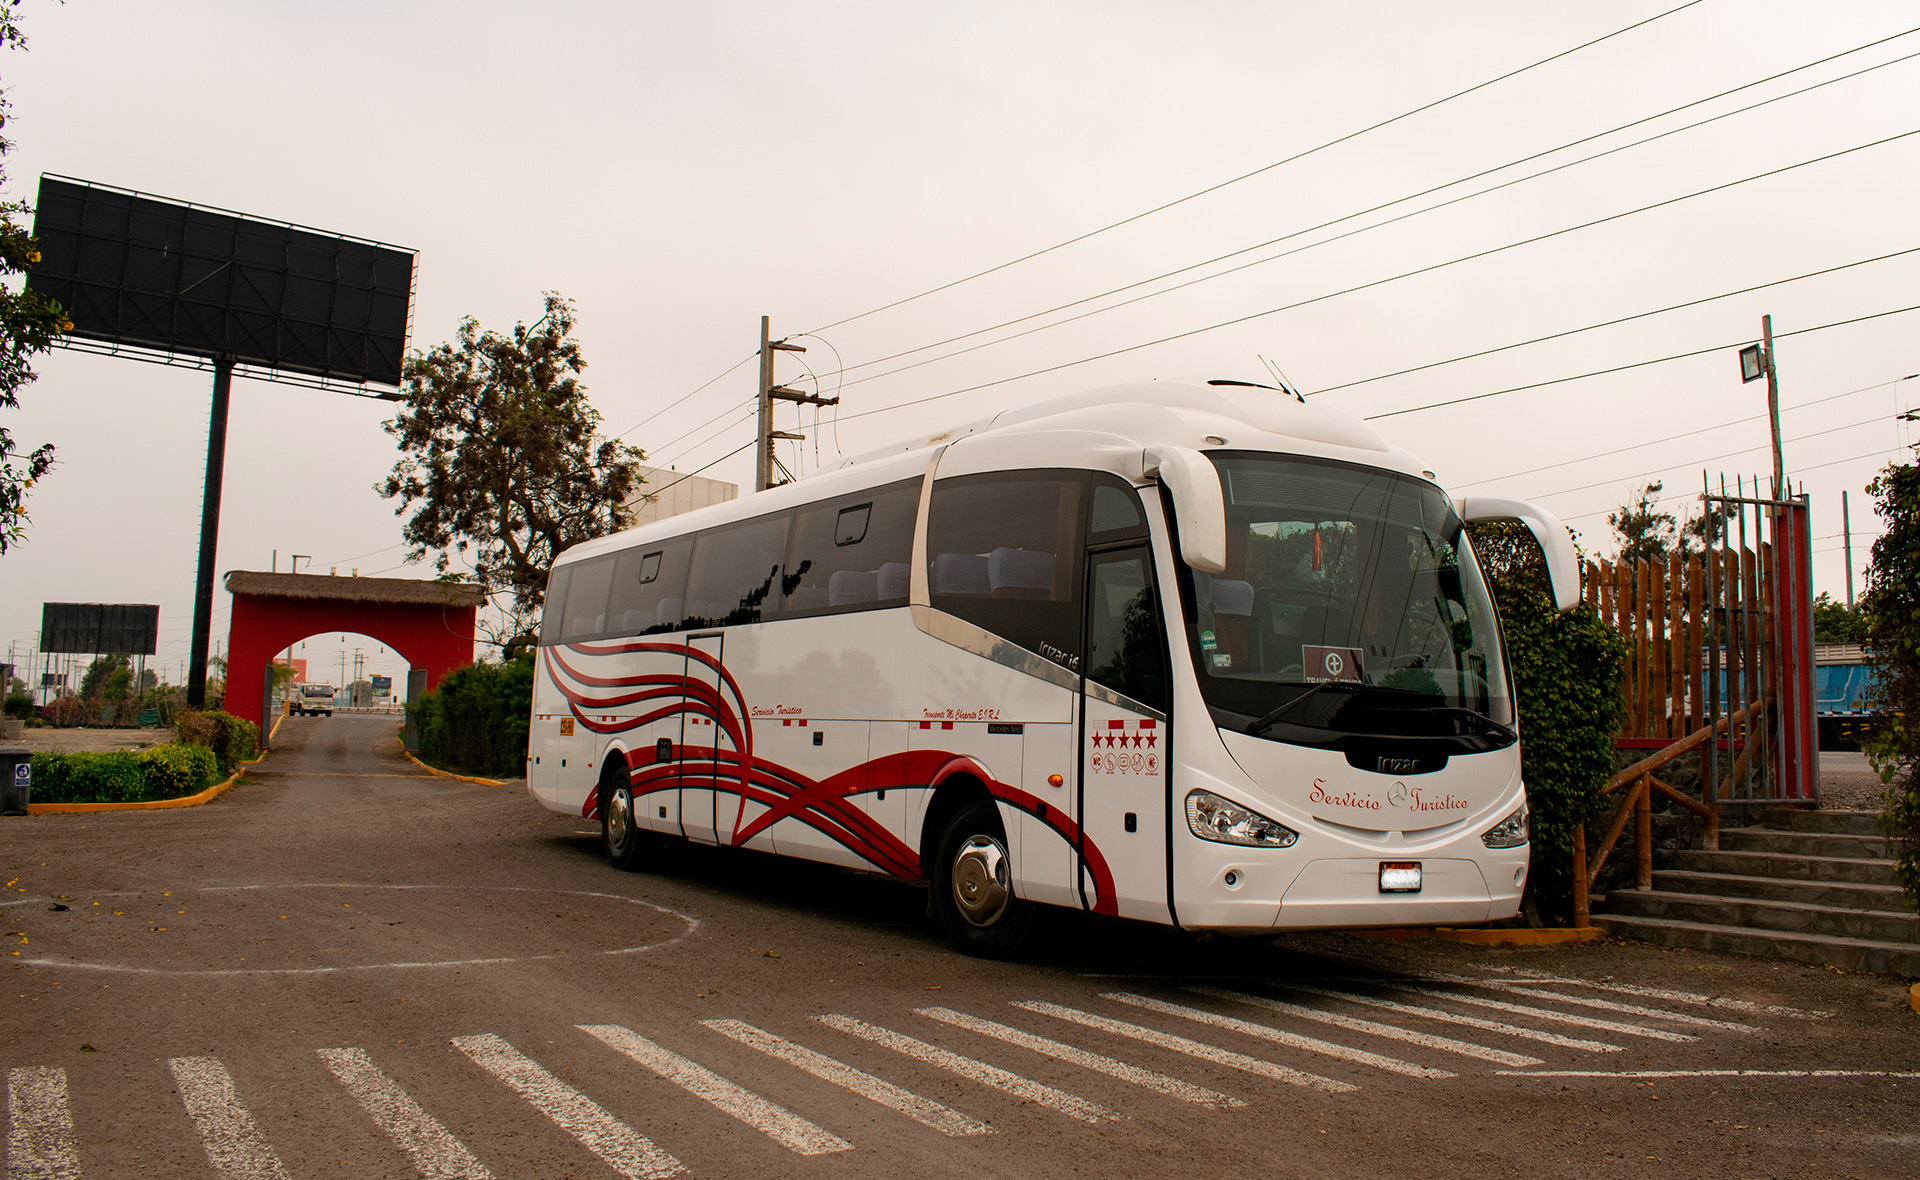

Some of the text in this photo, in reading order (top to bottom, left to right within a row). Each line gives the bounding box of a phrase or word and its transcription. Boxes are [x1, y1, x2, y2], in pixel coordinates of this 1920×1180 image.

[1068, 653, 1080, 670] i6
[751, 705, 775, 717] Servicio
[1309, 777, 1470, 812] Servicio Turistico
